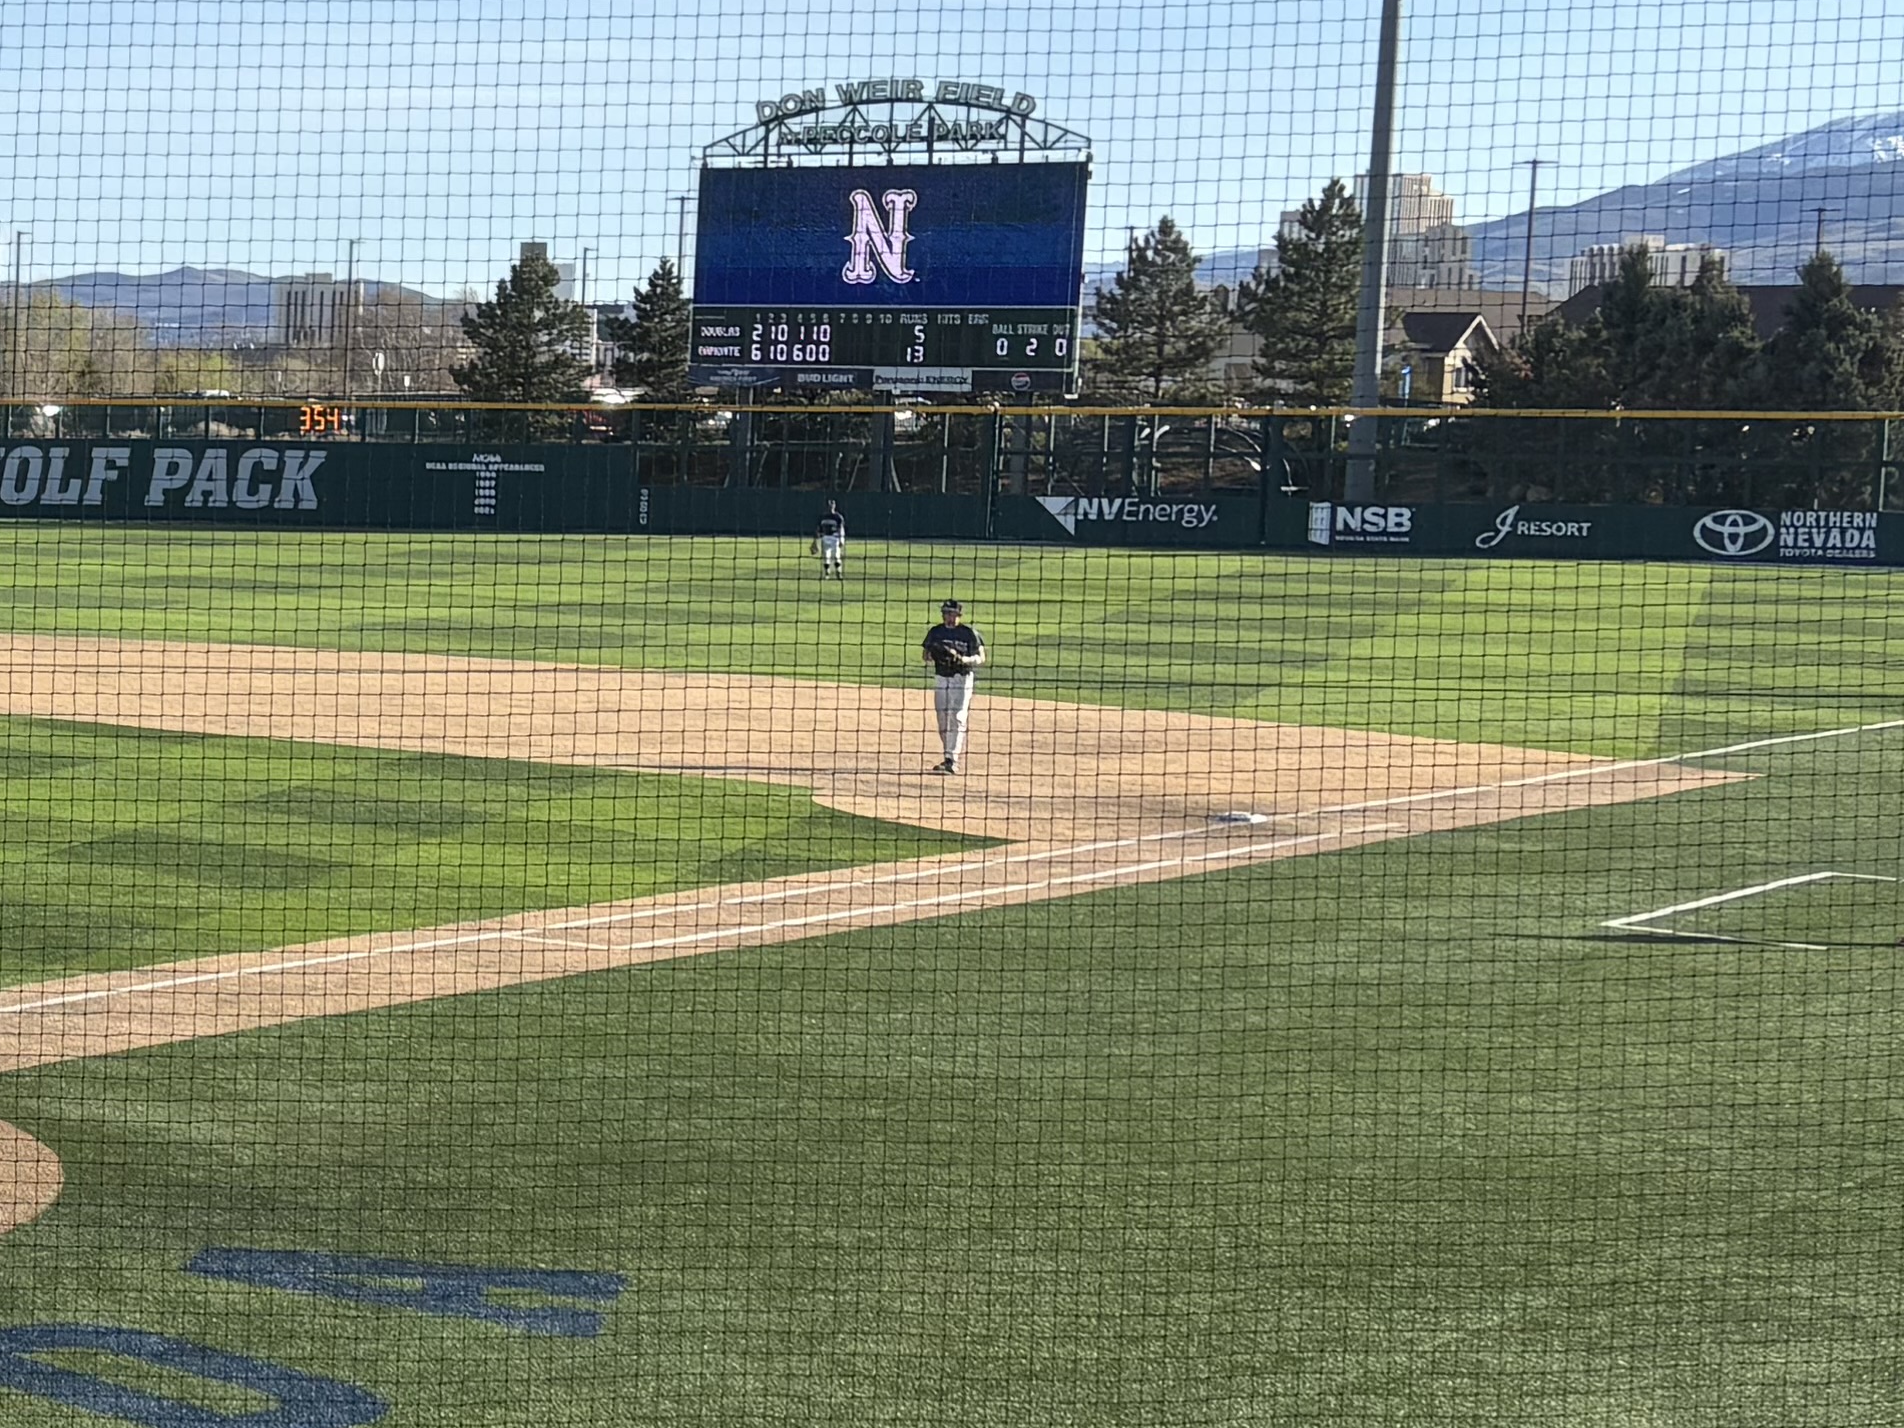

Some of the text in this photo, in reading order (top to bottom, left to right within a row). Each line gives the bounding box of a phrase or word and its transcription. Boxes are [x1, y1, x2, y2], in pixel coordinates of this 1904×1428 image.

[755, 79, 1037, 122] DON WEIR FIELD
[802, 125, 922, 143] PECCOLE
[932, 123, 1001, 141] PARK
[843, 188, 917, 284] N
[755, 313, 761, 323] 1
[768, 313, 775, 323] 2
[780, 313, 787, 323] 3
[796, 313, 803, 323] 4
[810, 313, 817, 323] 5
[823, 313, 830, 323] 6
[839, 313, 846, 324] 7
[852, 313, 859, 324] 8
[865, 314, 873, 324] 9
[879, 314, 893, 324] 10
[752, 324, 763, 341] 2
[770, 325, 775, 340] 1
[777, 324, 788, 341] 0
[800, 325, 805, 340] 1
[812, 325, 818, 340] 1
[819, 324, 831, 342] 0
[914, 325, 926, 343] 5
[992, 324, 1014, 335] BALL
[1017, 324, 1048, 335] STRIKE
[751, 344, 761, 361] 6
[777, 344, 787, 361] 0
[793, 344, 803, 362] 6
[806, 344, 816, 362] 0
[818, 344, 830, 362] 0
[906, 345, 925, 363] 13
[996, 338, 1067, 356] 0 2 0
[797, 374, 855, 384] BUD LIGHT
[144, 448, 328, 510] PACK
[1335, 506, 1412, 533] NSB
[1780, 511, 1878, 528] NORTHERN
[1517, 522, 1591, 537] RESORT
[1779, 527, 1876, 548] NEVADA
[1779, 548, 1824, 558] TOYOTA
